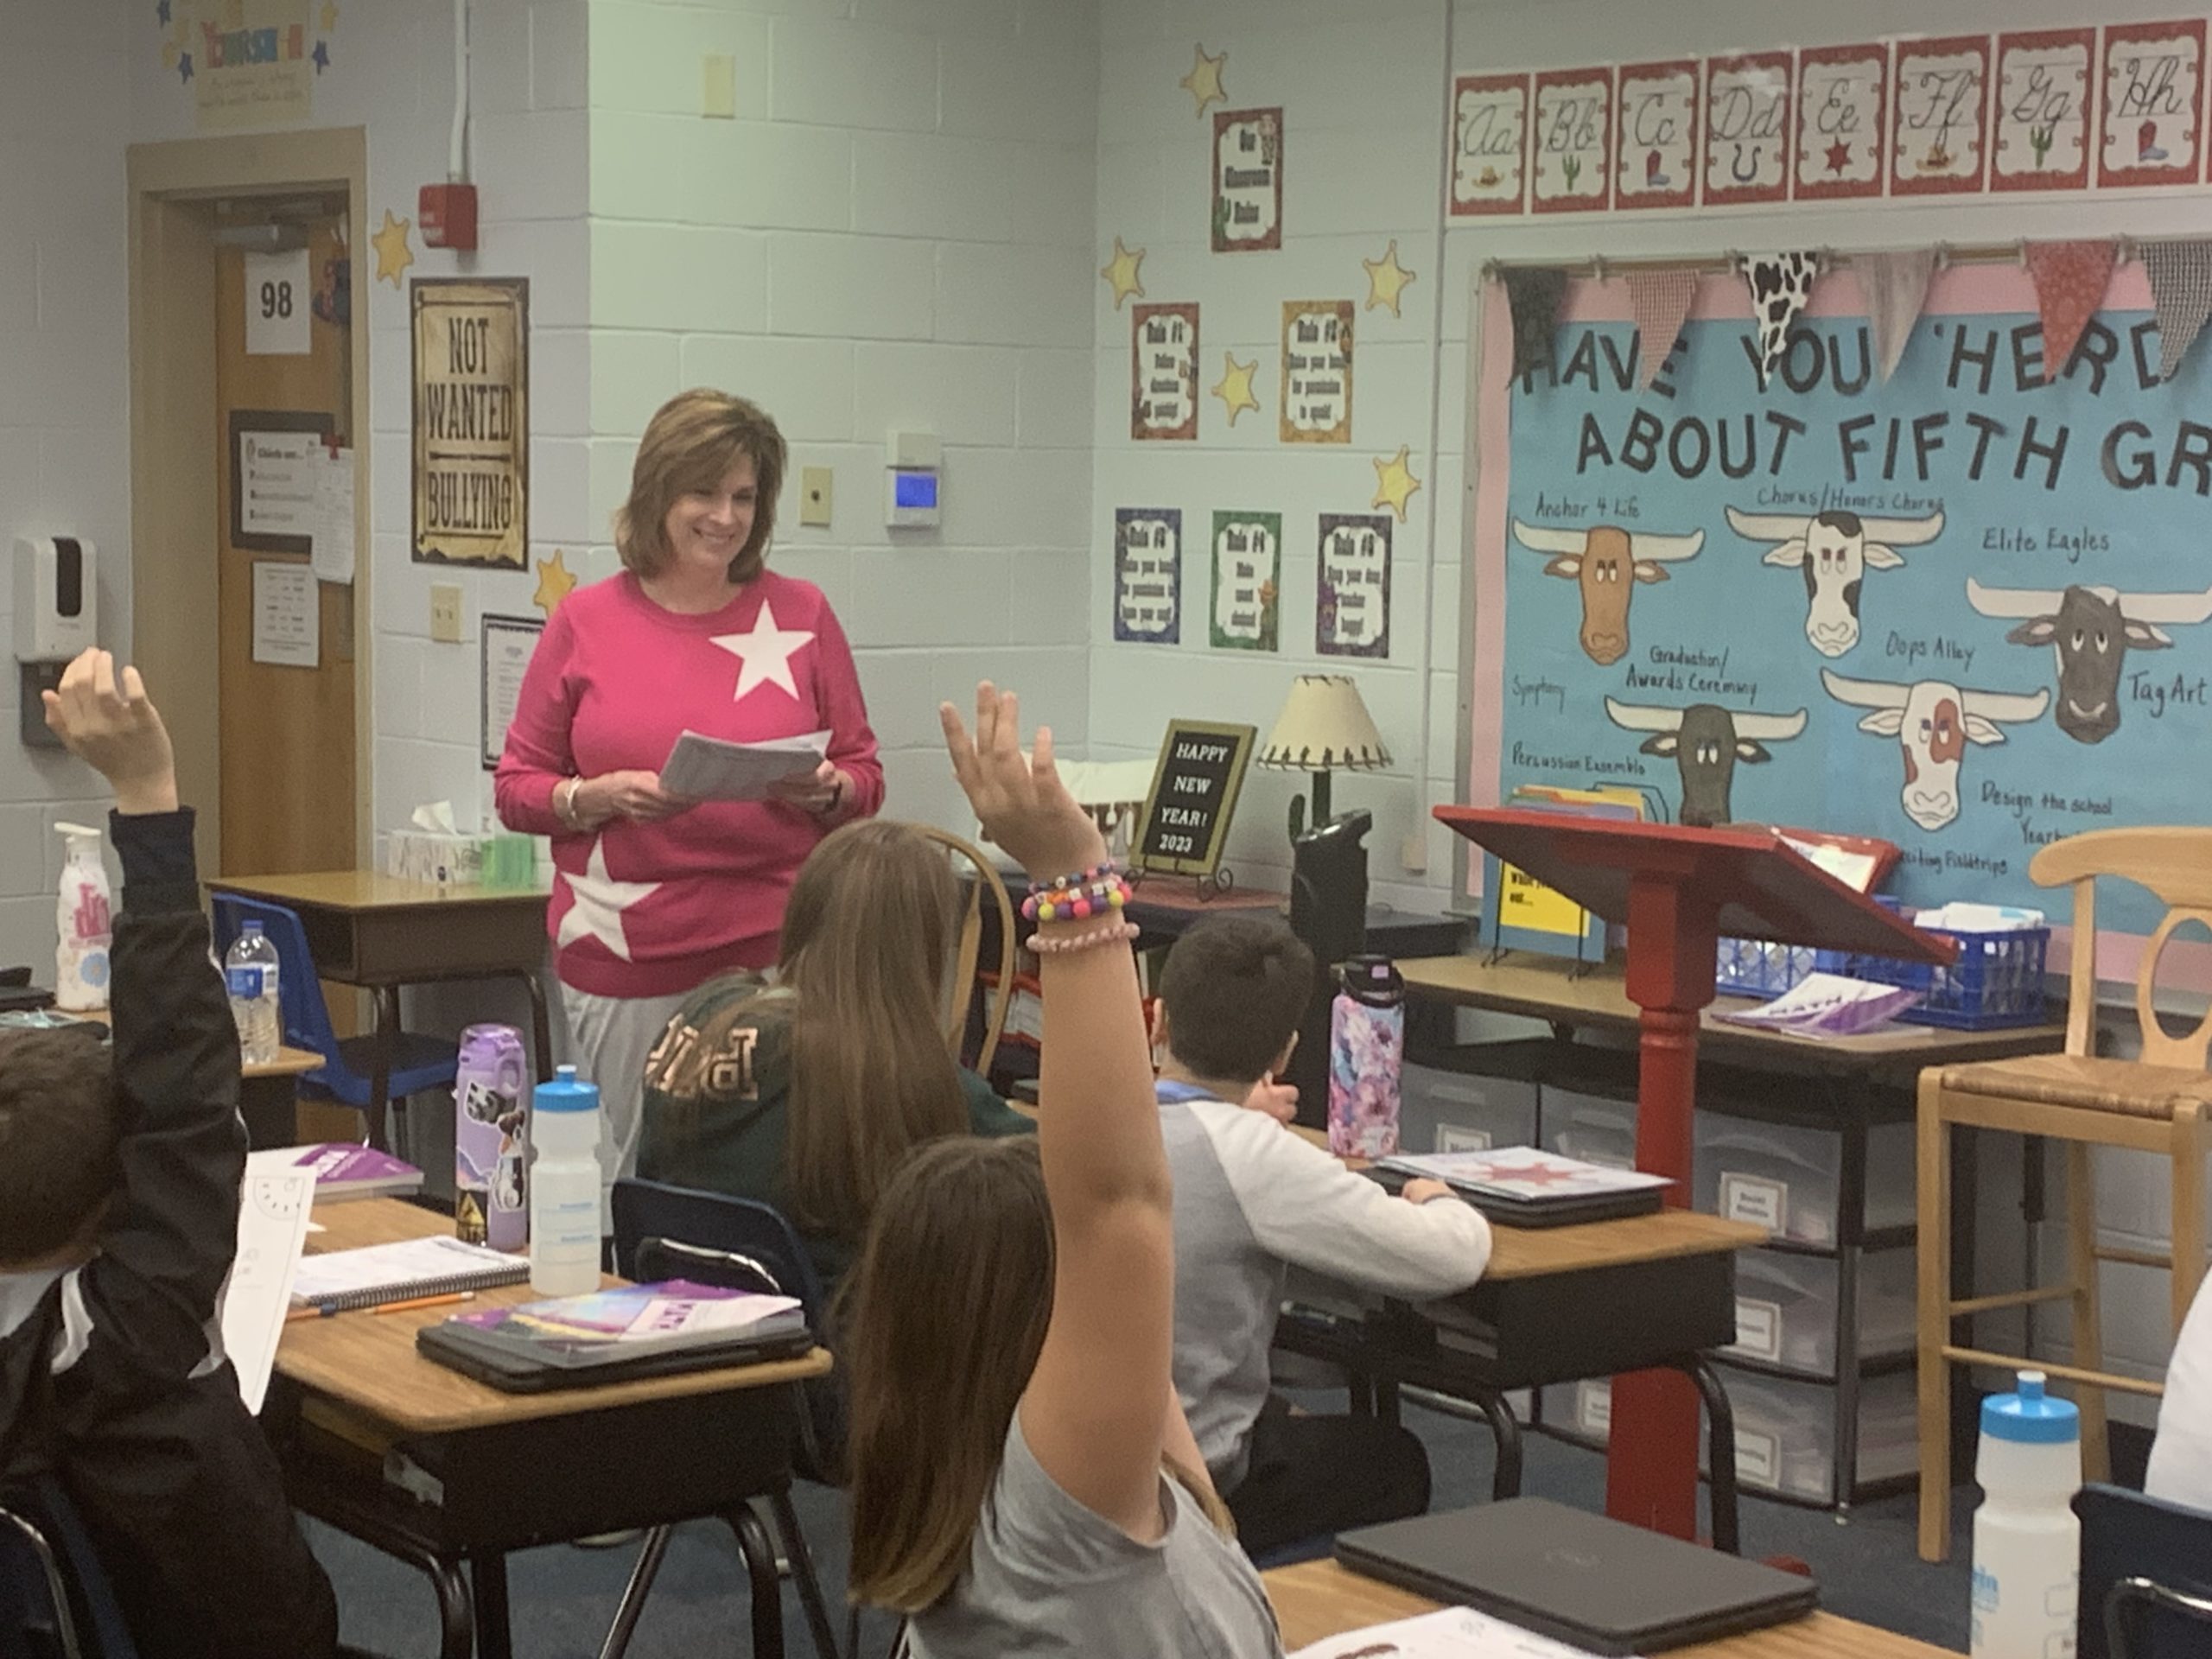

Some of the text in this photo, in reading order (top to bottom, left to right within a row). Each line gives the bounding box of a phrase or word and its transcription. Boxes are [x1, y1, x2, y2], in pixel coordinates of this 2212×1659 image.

[1547, 97, 1598, 152] Bb
[1635, 92, 1676, 147] Cc
[1712, 86, 1785, 140] Dd
[1817, 78, 1859, 133] Ee
[1464, 104, 1516, 156] Aa
[261, 281, 292, 320] 98
[448, 316, 490, 375] NOT
[1739, 327, 1872, 397] YOU
[427, 382, 512, 442] WANTED
[1577, 406, 2212, 497] ABOUT FIFTH GR
[427, 471, 512, 531] BULLYING
[1535, 490, 1640, 519] Anchor 4 Life
[1891, 492, 1944, 511] Chorus
[1982, 528, 2110, 563] Elite Eagles
[1933, 634, 1975, 672] Alley
[1625, 662, 1684, 691] Awards
[2126, 671, 2208, 718] Tag Art
[1176, 742, 1229, 763] HAPPY
[1173, 774, 1211, 794] NEW
[1981, 779, 2113, 819] Design the school
[1160, 806, 1208, 828] YEAR!
[2020, 816, 2081, 845] Yearb
[1159, 834, 1193, 853] 2023
